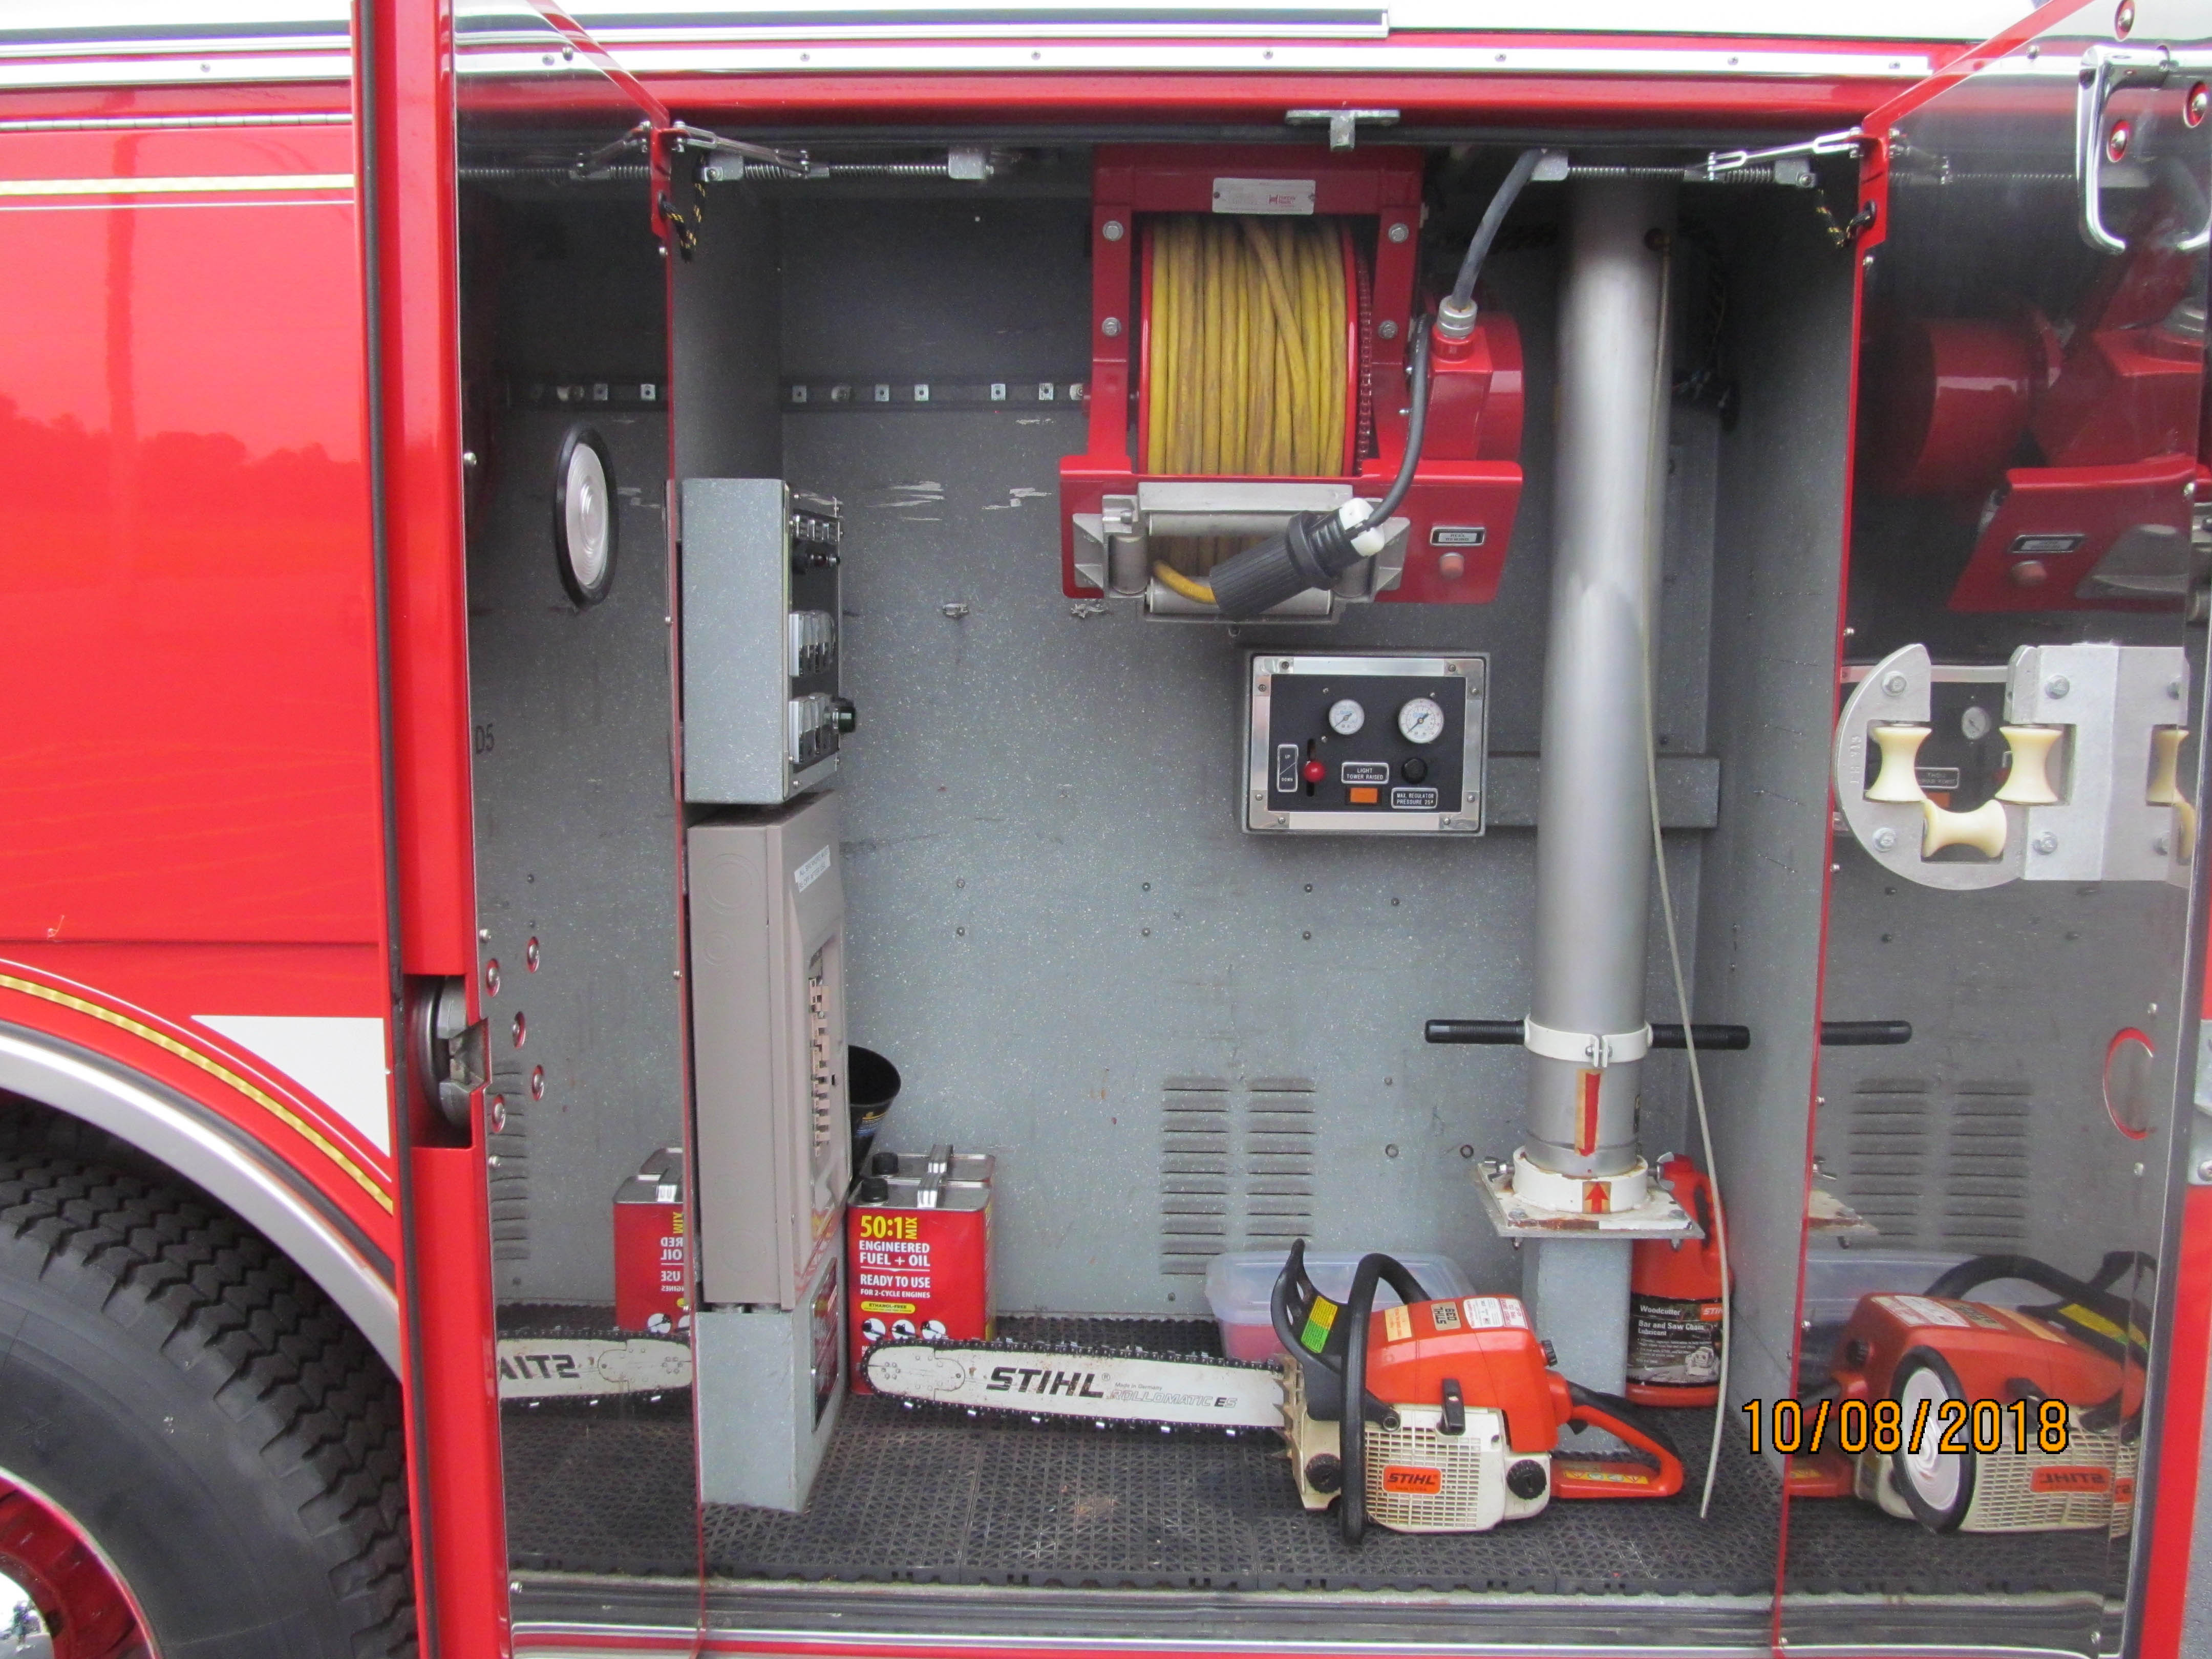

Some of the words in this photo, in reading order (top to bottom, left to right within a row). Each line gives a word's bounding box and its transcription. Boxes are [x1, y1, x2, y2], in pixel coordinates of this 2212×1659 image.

[860, 1215, 903, 1239] 50:1
[905, 1217, 918, 1240] MIX
[859, 1240, 930, 1253] ENGINEERED
[860, 1252, 891, 1265] FUEL
[894, 1256, 905, 1266] +
[908, 1254, 930, 1267] OIL
[860, 1273, 894, 1287] READY
[895, 1276, 909, 1287] TO
[911, 1277, 931, 1288] USE
[1434, 1306, 1447, 1325] STIHL
[1640, 1305, 1682, 1316] Woodcutter
[1638, 1327, 1667, 1336] Lubricant
[1653, 1321, 1666, 1329] and
[1667, 1322, 1684, 1331] Saw
[986, 1366, 1104, 1398] STIHL
[1110, 1389, 1214, 1407] ROLLOMATIC
[1387, 1472, 1436, 1485] STIHL
